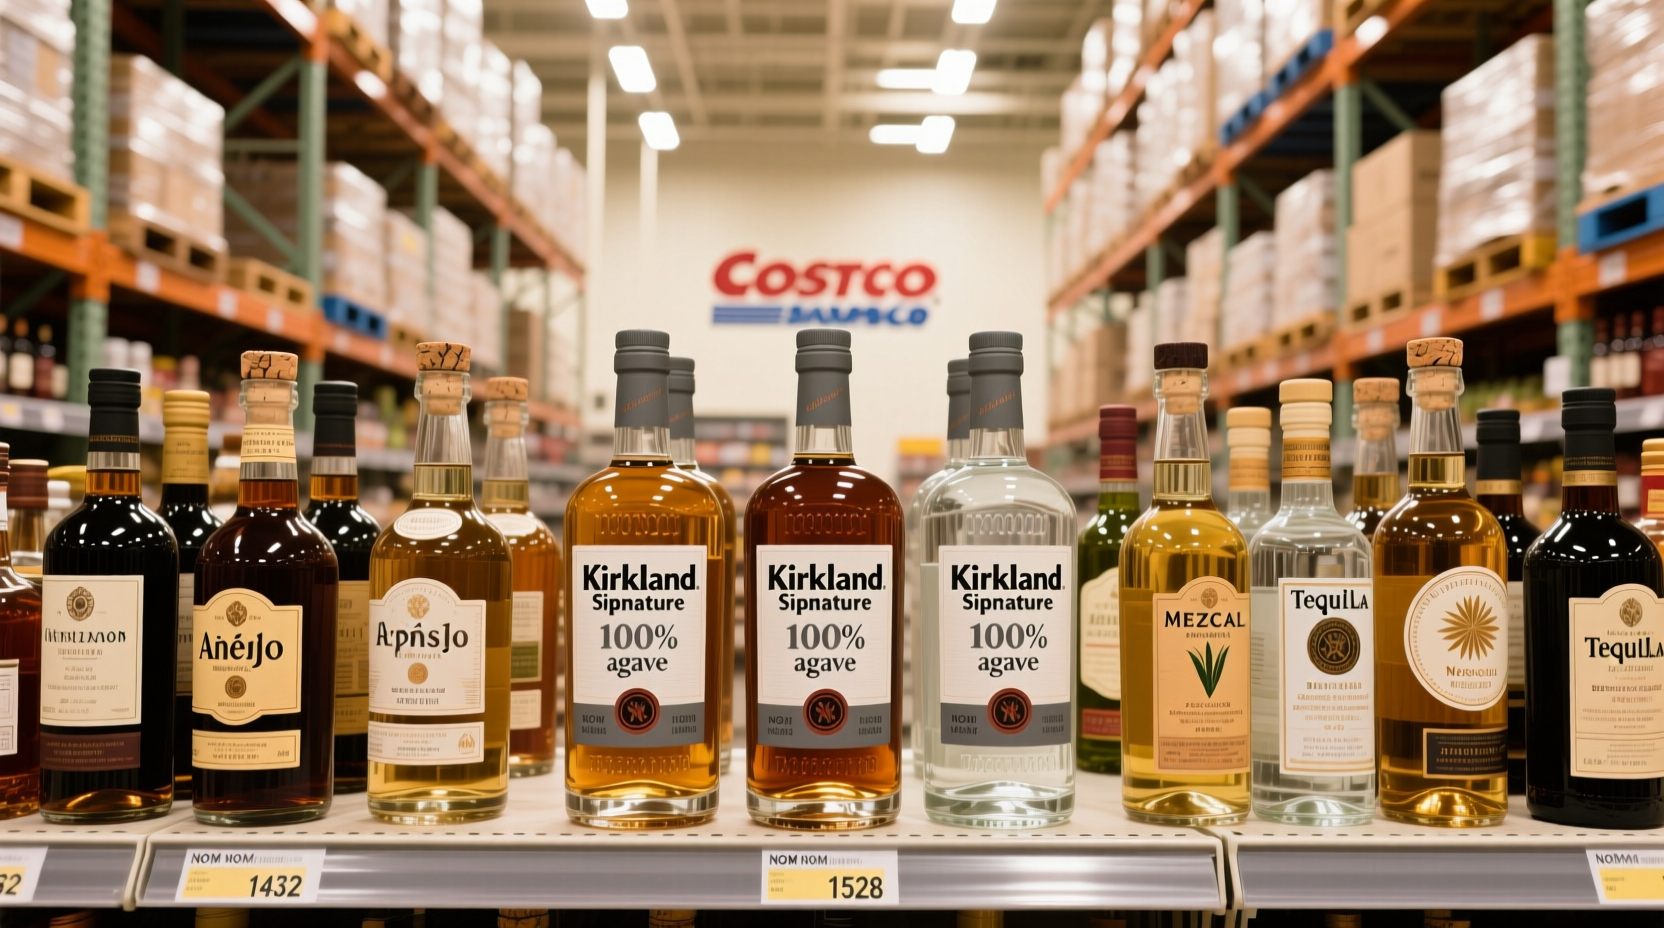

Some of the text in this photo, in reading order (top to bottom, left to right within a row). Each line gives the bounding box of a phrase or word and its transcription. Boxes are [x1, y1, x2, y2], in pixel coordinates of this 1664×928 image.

[714, 252, 936, 297] COSTCO
[592, 593, 685, 616] Sipnature
[778, 592, 872, 616] Sipnature
[962, 592, 1053, 616] Sipnature
[1164, 610, 1246, 628] MEZCAL
[600, 623, 678, 650] 100%
[786, 623, 865, 650] 100%
[969, 622, 1047, 650] 100%
[606, 656, 668, 679] agave
[794, 656, 856, 679] agave
[978, 656, 1039, 678] agave
[769, 854, 798, 865] NOM
[249, 874, 303, 897] 1432
[828, 875, 883, 899] 1528
